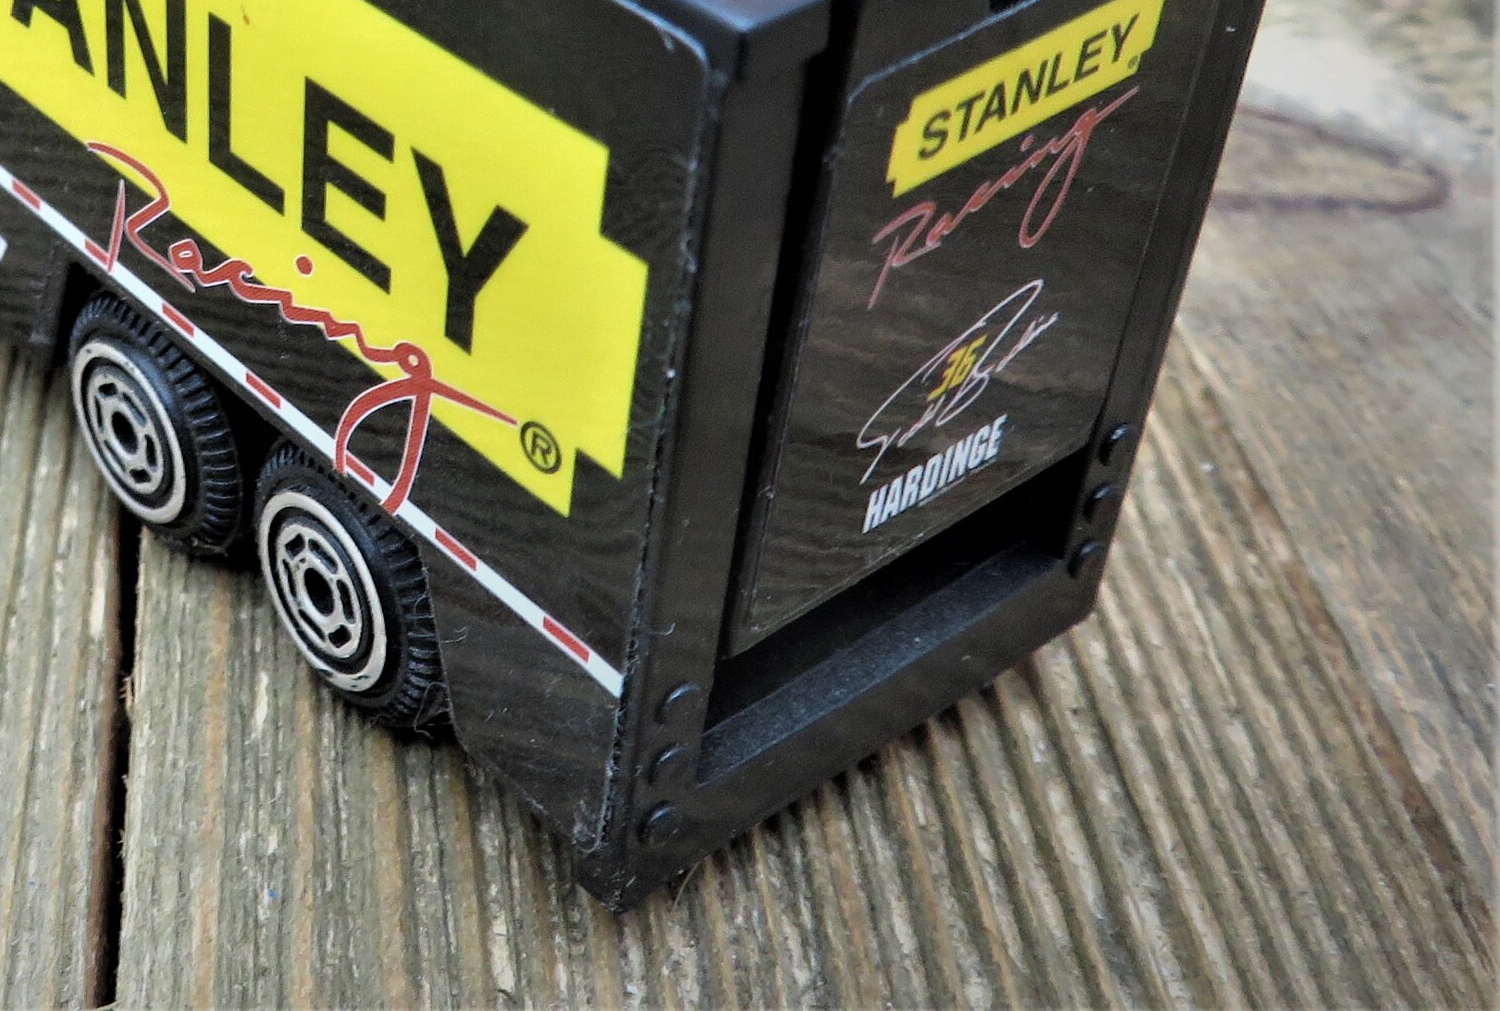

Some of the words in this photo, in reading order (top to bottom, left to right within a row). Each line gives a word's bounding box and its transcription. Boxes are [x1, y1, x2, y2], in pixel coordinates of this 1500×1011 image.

[916, 11, 1141, 161] STANLEY
[866, 85, 1140, 311] Racing
[86, 141, 519, 516] Racing
[861, 413, 1009, 535] HARDINGE
